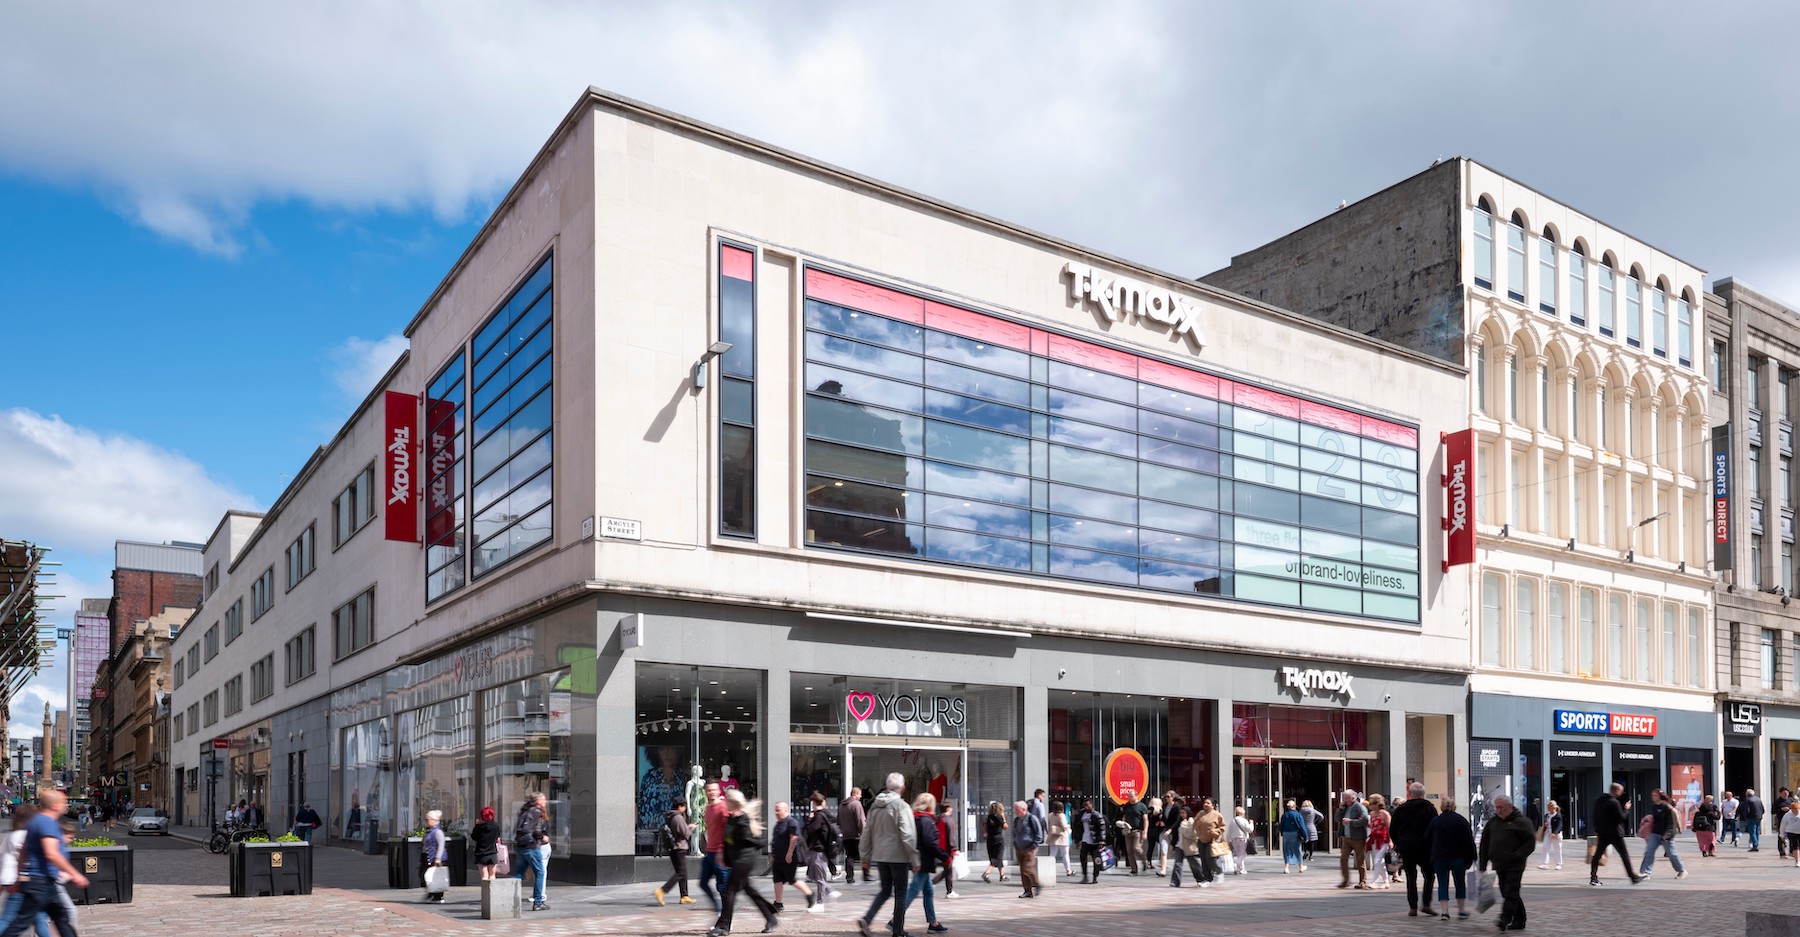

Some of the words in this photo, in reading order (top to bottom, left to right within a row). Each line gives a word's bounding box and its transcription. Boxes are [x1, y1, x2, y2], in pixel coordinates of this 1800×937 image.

[1716, 454, 1726, 495] SPORTS
[607, 526, 636, 535] STREET
[1716, 500, 1727, 540] DIRECT
[877, 693, 965, 726] YOURS
[1731, 703, 1760, 724] USC
[1560, 711, 1607, 731] SPORTS
[1612, 715, 1655, 734] DIRECT
[1119, 780, 1136, 788] small
